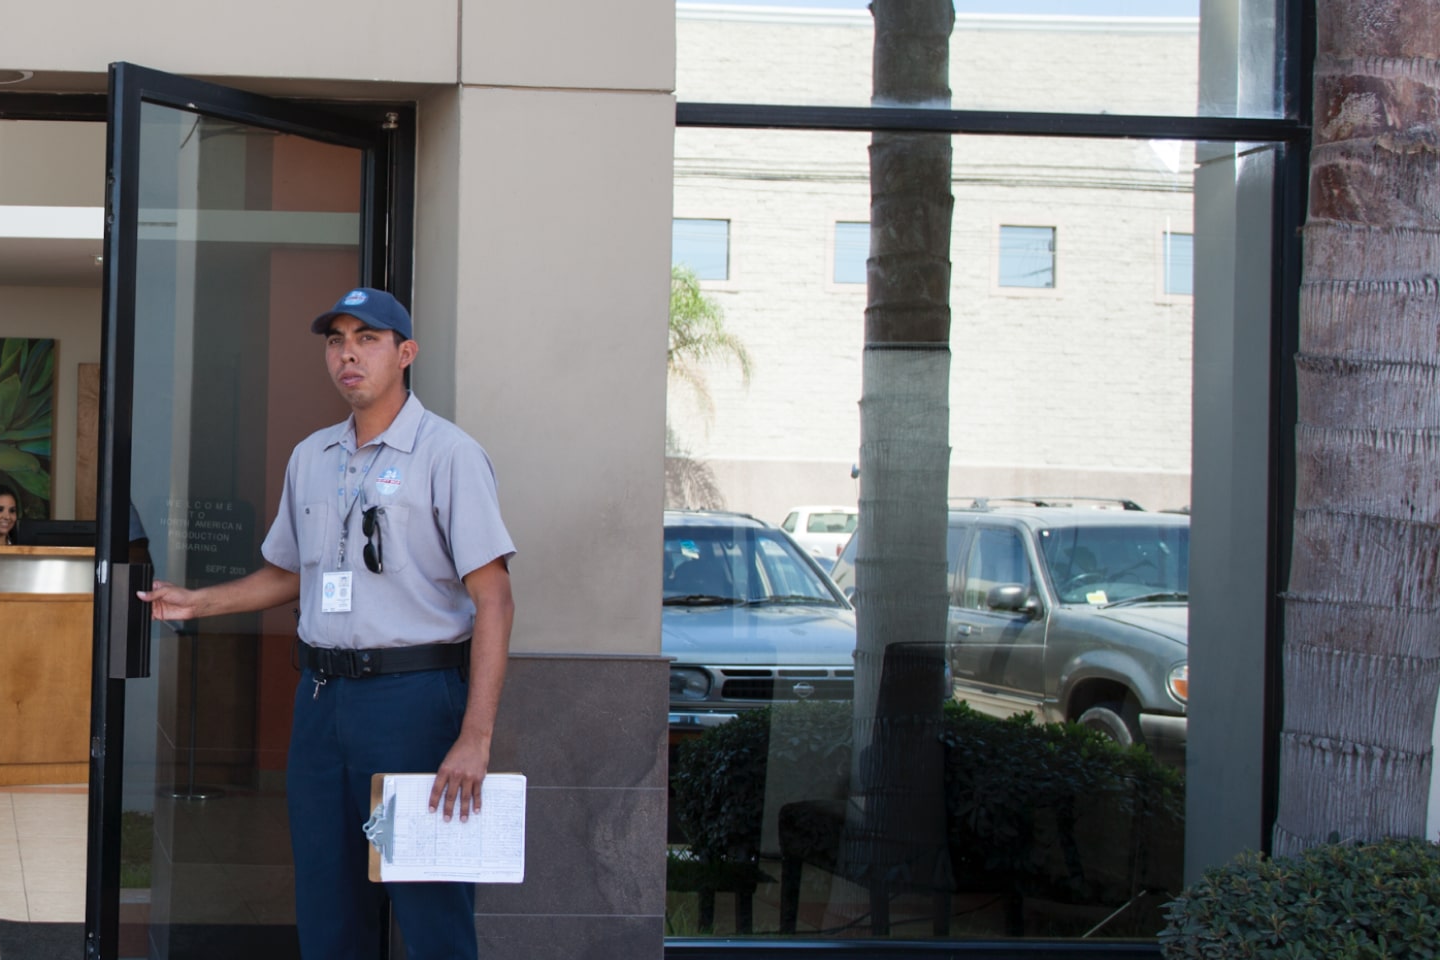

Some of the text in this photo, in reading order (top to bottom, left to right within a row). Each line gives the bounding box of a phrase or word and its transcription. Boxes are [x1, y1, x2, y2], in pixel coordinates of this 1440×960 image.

[166, 499, 233, 511] WELCOME
[189, 511, 206, 519] TO
[160, 518, 243, 531] NORTH AMERICAN
[168, 530, 230, 542] PRODUCTION
[175, 542, 218, 553] SHARING
